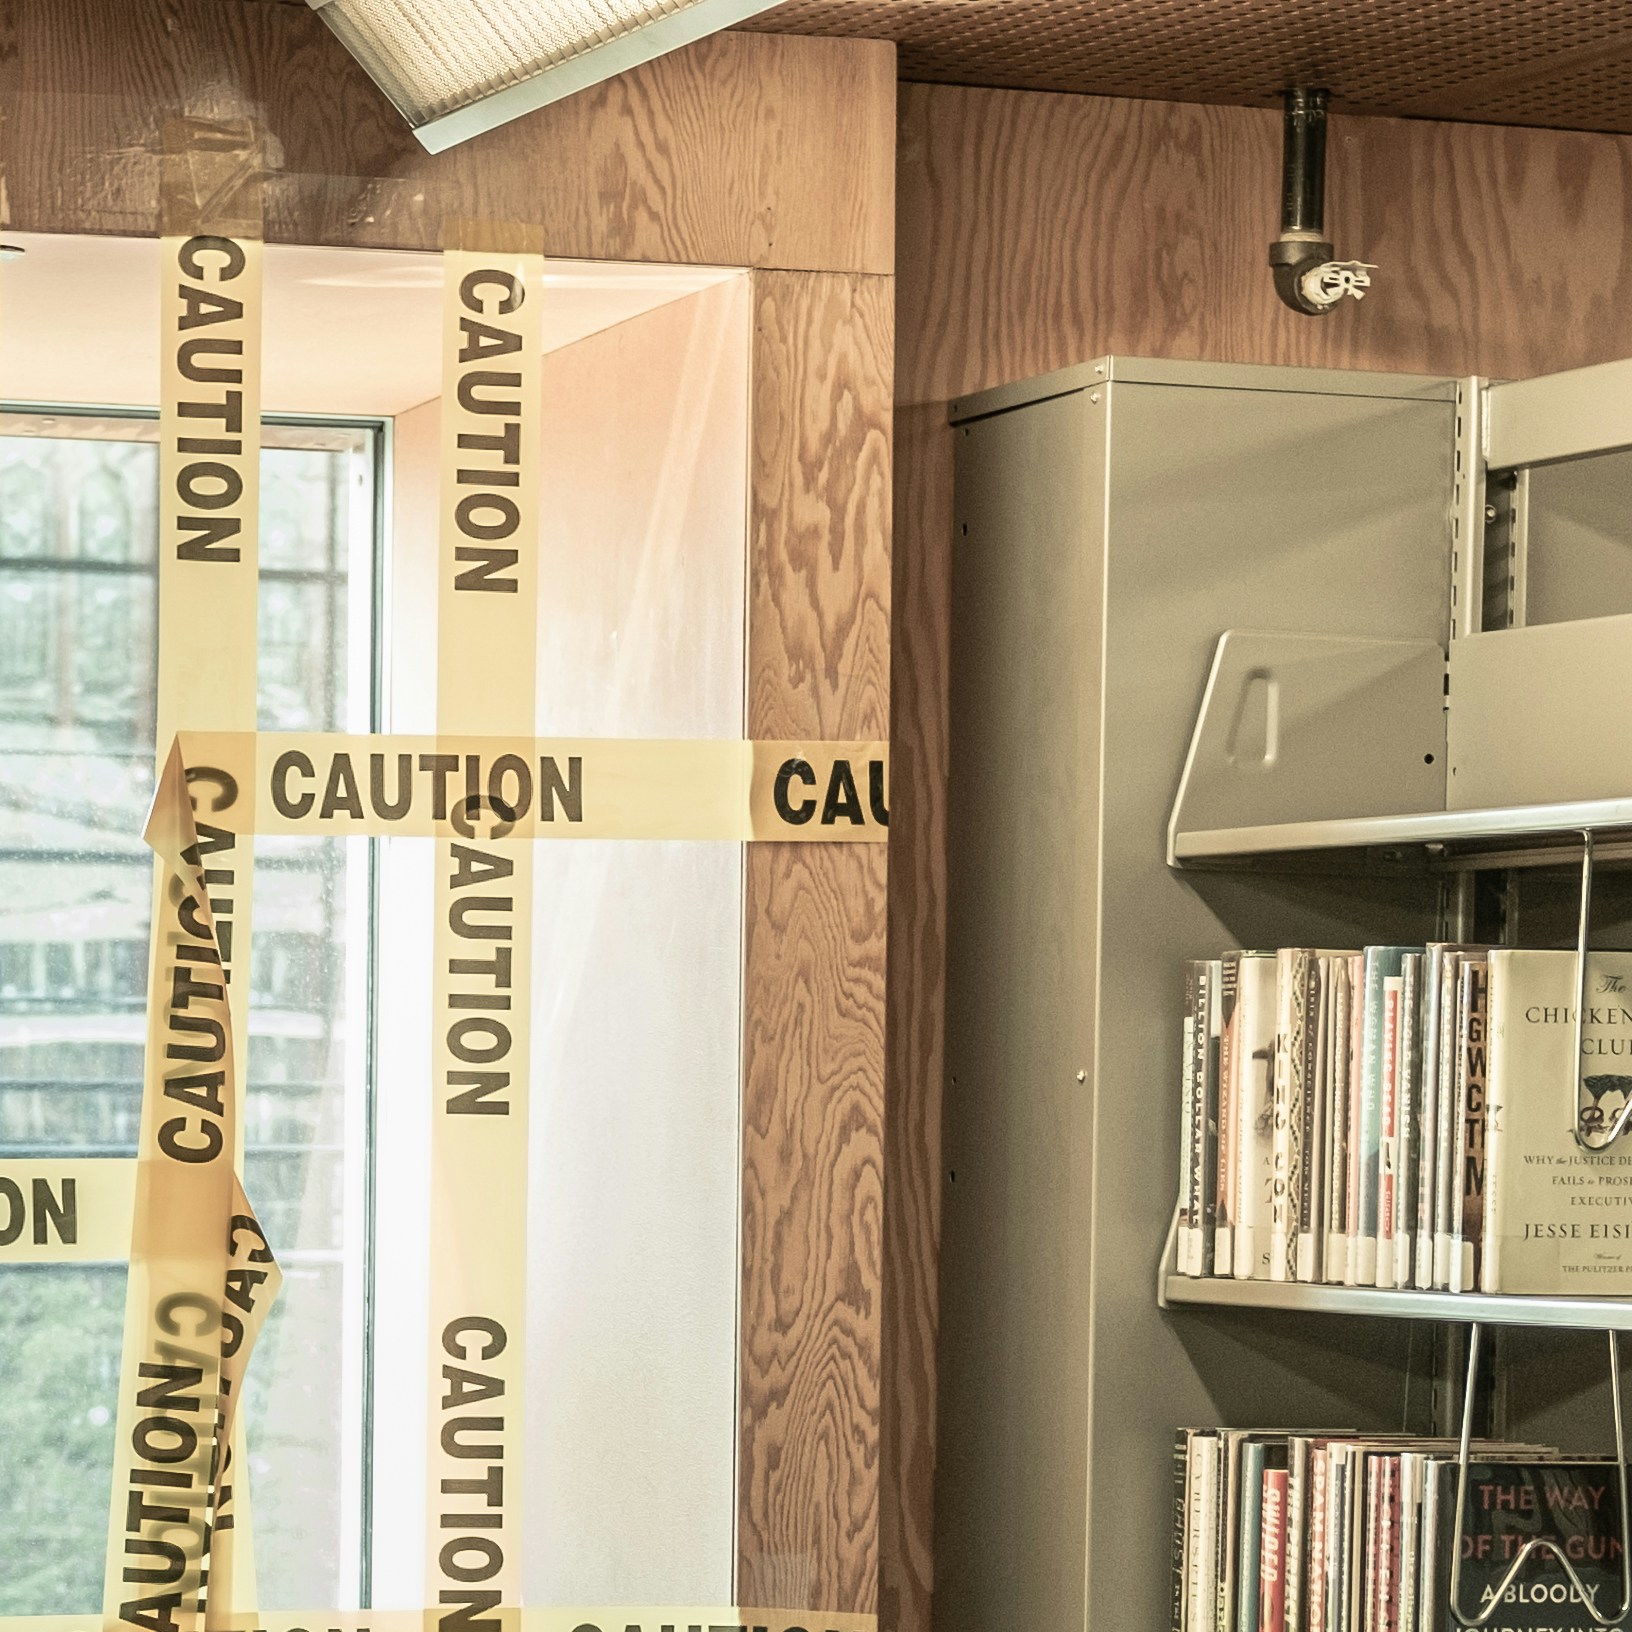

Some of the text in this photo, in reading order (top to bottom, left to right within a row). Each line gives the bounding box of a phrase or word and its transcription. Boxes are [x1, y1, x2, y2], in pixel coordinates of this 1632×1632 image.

[177, 235, 246, 563] CAUTION
[454, 269, 525, 593] CAUTION
[270, 750, 583, 823] CAUTION
[446, 794, 516, 1115] CAUTION
[1597, 974, 1626, 994] The
[1524, 1156, 1553, 1165] WHY
[1568, 1156, 1614, 1167] JUSTICE
[1552, 1176, 1582, 1186] FAILS
[1524, 1223, 1582, 1240] JESSE
[1479, 1486, 1605, 1511] THE WAY
[1461, 1535, 1625, 1560] OF THE GUN
[1480, 1584, 1599, 1603] A BLOODY
